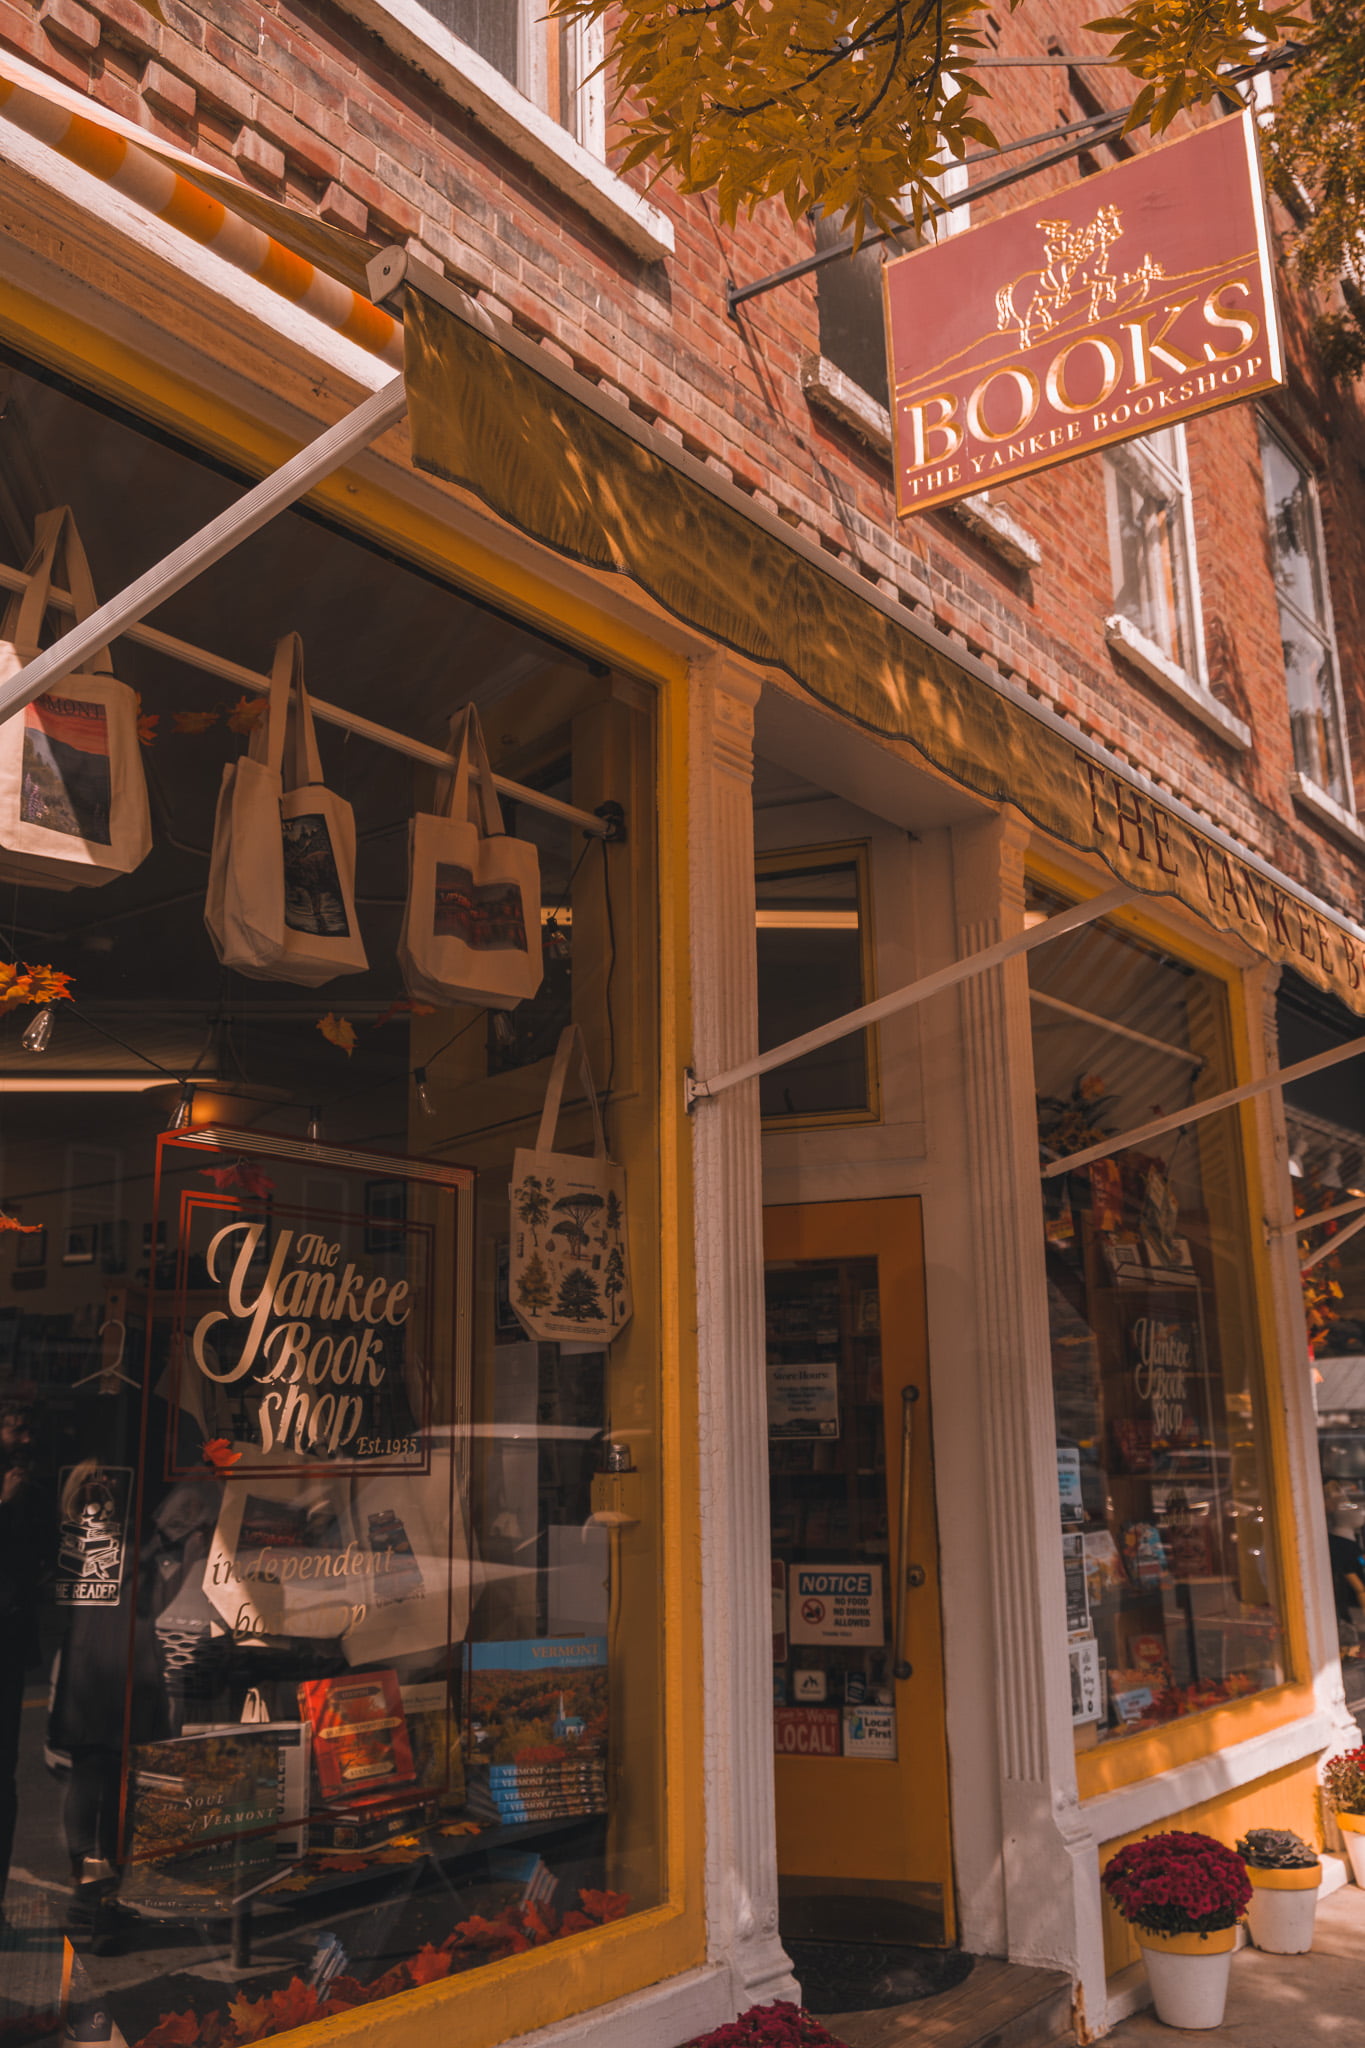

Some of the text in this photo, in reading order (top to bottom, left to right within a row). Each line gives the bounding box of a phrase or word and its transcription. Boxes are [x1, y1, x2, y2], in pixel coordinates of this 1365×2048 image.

[904, 278, 1260, 474] BOOKS
[908, 356, 1262, 496] THE YANKEE BOOKSHOP
[1075, 750, 1179, 877] THE
[1190, 835, 1334, 975] YANKEE
[296, 1233, 341, 1268] The
[193, 1222, 411, 1384] Yankee
[252, 1321, 386, 1387] Book
[212, 1540, 396, 1586] independent
[72, 1583, 117, 1599] READER
[801, 1576, 869, 1592] NOTICE
[835, 1598, 869, 1606] NO FOOD
[833, 1608, 870, 1617] NO DRINK
[834, 1619, 870, 1628] ALLOWED
[531, 1643, 599, 1659] VERMONT
[864, 1717, 891, 1727] Local
[868, 1729, 892, 1738] First
[502, 1766, 545, 1776] VERMONT
[502, 1777, 544, 1787] VERMONT
[503, 1791, 545, 1800] VERMONT
[202, 1808, 276, 1830] VERMONT
